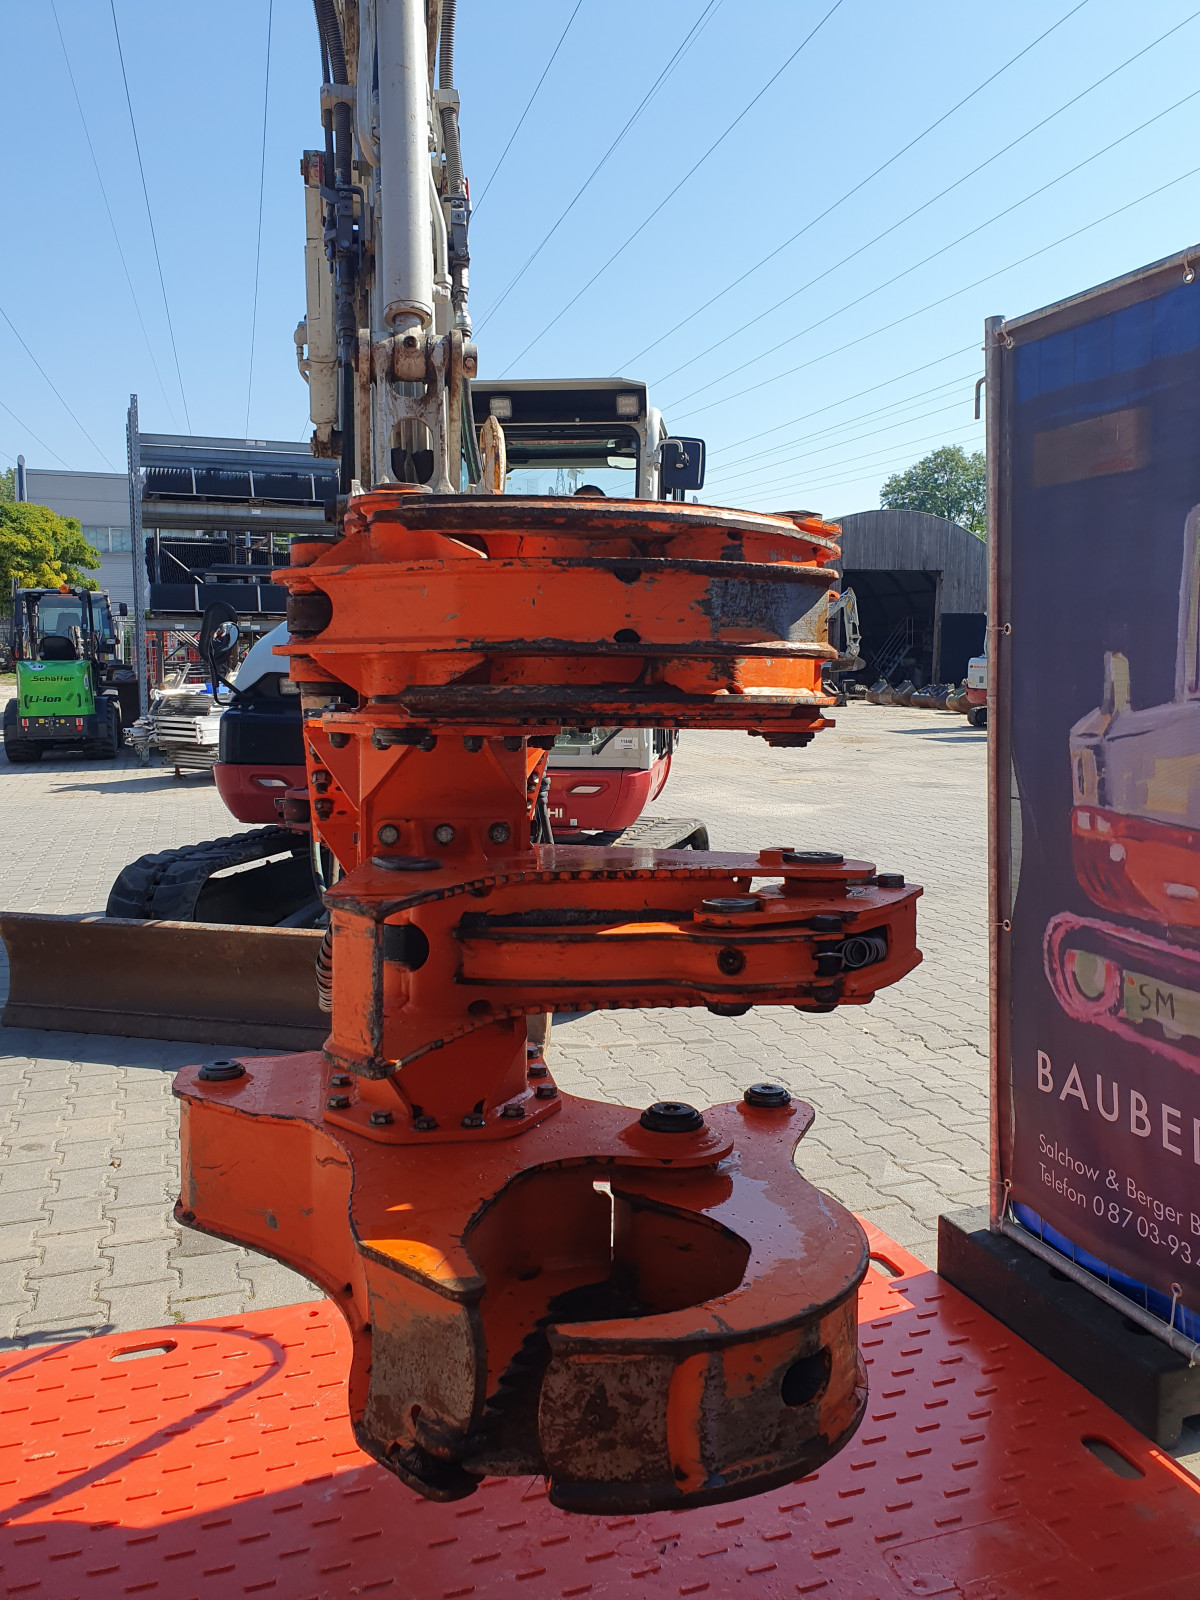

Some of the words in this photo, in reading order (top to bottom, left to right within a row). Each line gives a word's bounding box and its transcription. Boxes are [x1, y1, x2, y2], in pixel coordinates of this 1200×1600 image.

[29, 695, 62, 703] Li-Ion
[1038, 1133, 1100, 1182] Salchow
[1105, 1168, 1120, 1191] &
[1126, 1176, 1184, 1225] Berger
[1038, 1161, 1087, 1208] Telefon
